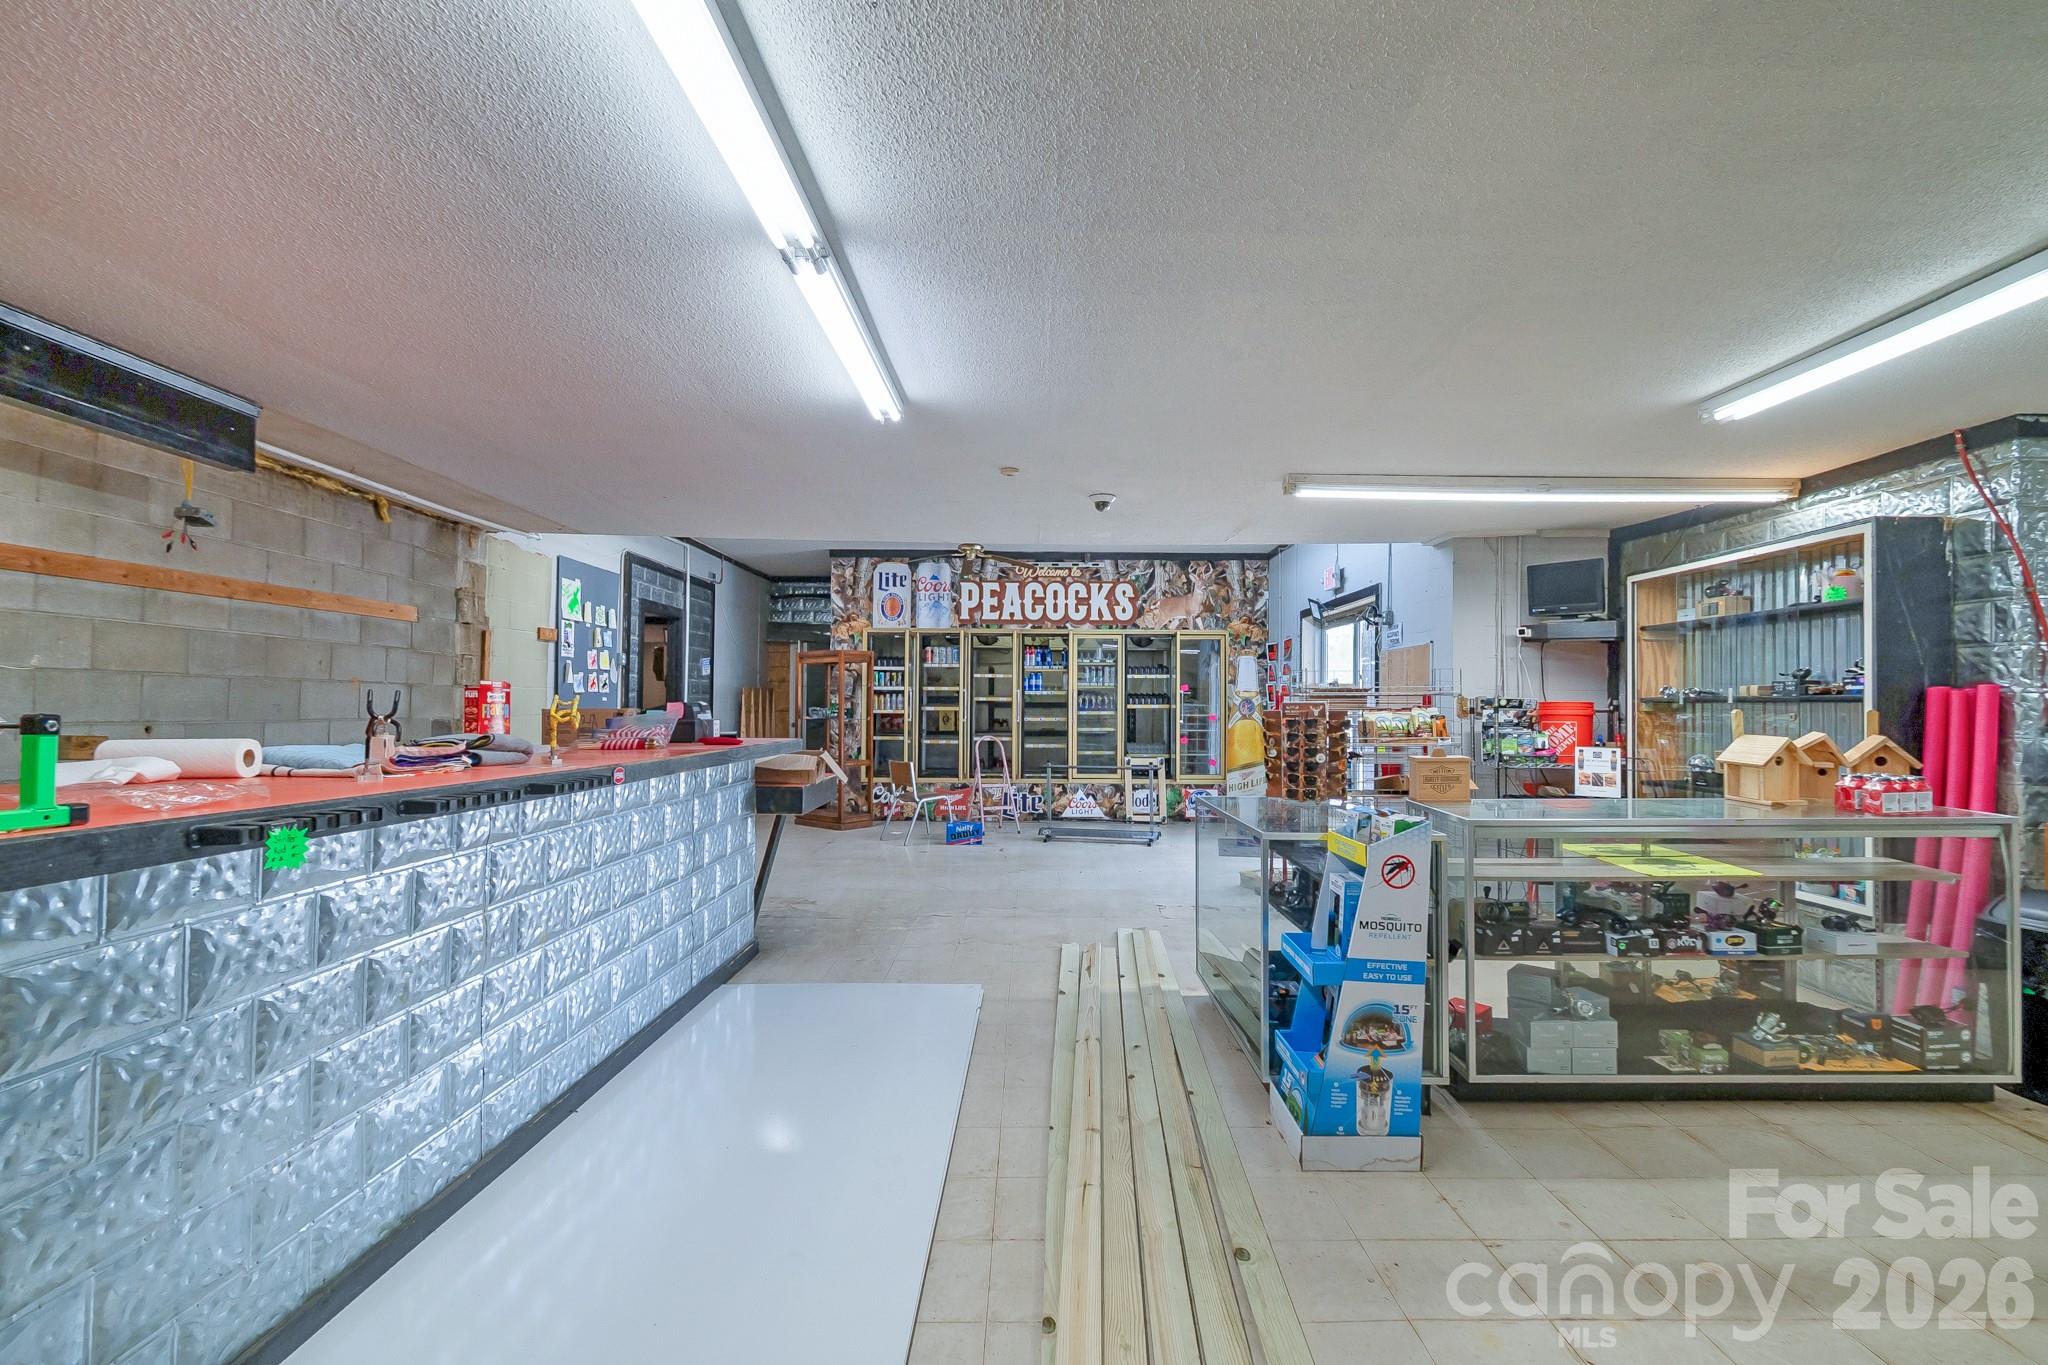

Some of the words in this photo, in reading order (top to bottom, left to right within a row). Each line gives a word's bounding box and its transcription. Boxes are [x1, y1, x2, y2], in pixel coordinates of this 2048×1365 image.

[1015, 566, 1068, 577] Welcome
[1071, 565, 1082, 577] to
[878, 571, 907, 591] Lite
[960, 581, 1134, 621] PEACOCKS
[1548, 720, 1576, 749] OME
[1228, 781, 1249, 793] HIGH
[1068, 797, 1098, 809] Coors
[1071, 808, 1094, 816] LIGHT
[955, 824, 974, 833] Natty
[950, 830, 981, 841] DADDY
[1360, 920, 1423, 933] MOSQUITO
[1368, 932, 1412, 941] REPELLENT
[1366, 961, 1408, 971] EFFECTIVE
[1363, 972, 1383, 980] EASY
[1386, 973, 1396, 981] TO
[1397, 974, 1413, 982] USE
[1393, 1004, 1410, 1015] 15
